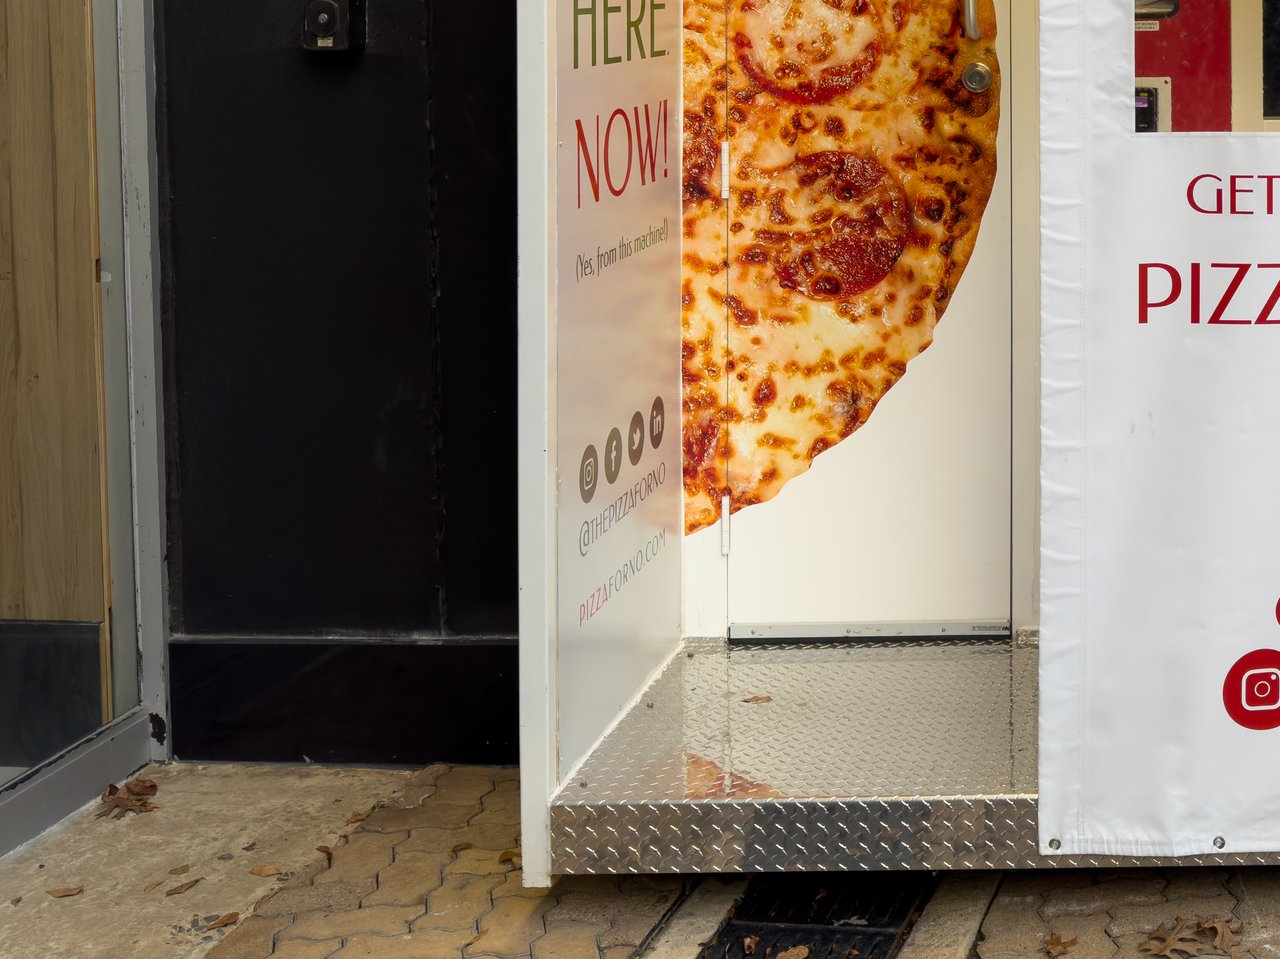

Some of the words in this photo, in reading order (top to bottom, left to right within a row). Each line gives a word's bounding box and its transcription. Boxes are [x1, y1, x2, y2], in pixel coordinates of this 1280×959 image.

[574, 99, 668, 209] NOW!
[576, 252, 595, 284] (Yes,
[597, 246, 617, 277] from
[619, 236, 633, 260] this
[634, 217, 669, 254] machine!)
[579, 461, 666, 558] @THEPIZZAFORNO
[579, 527, 666, 628] PIZZAFORNO.COM
